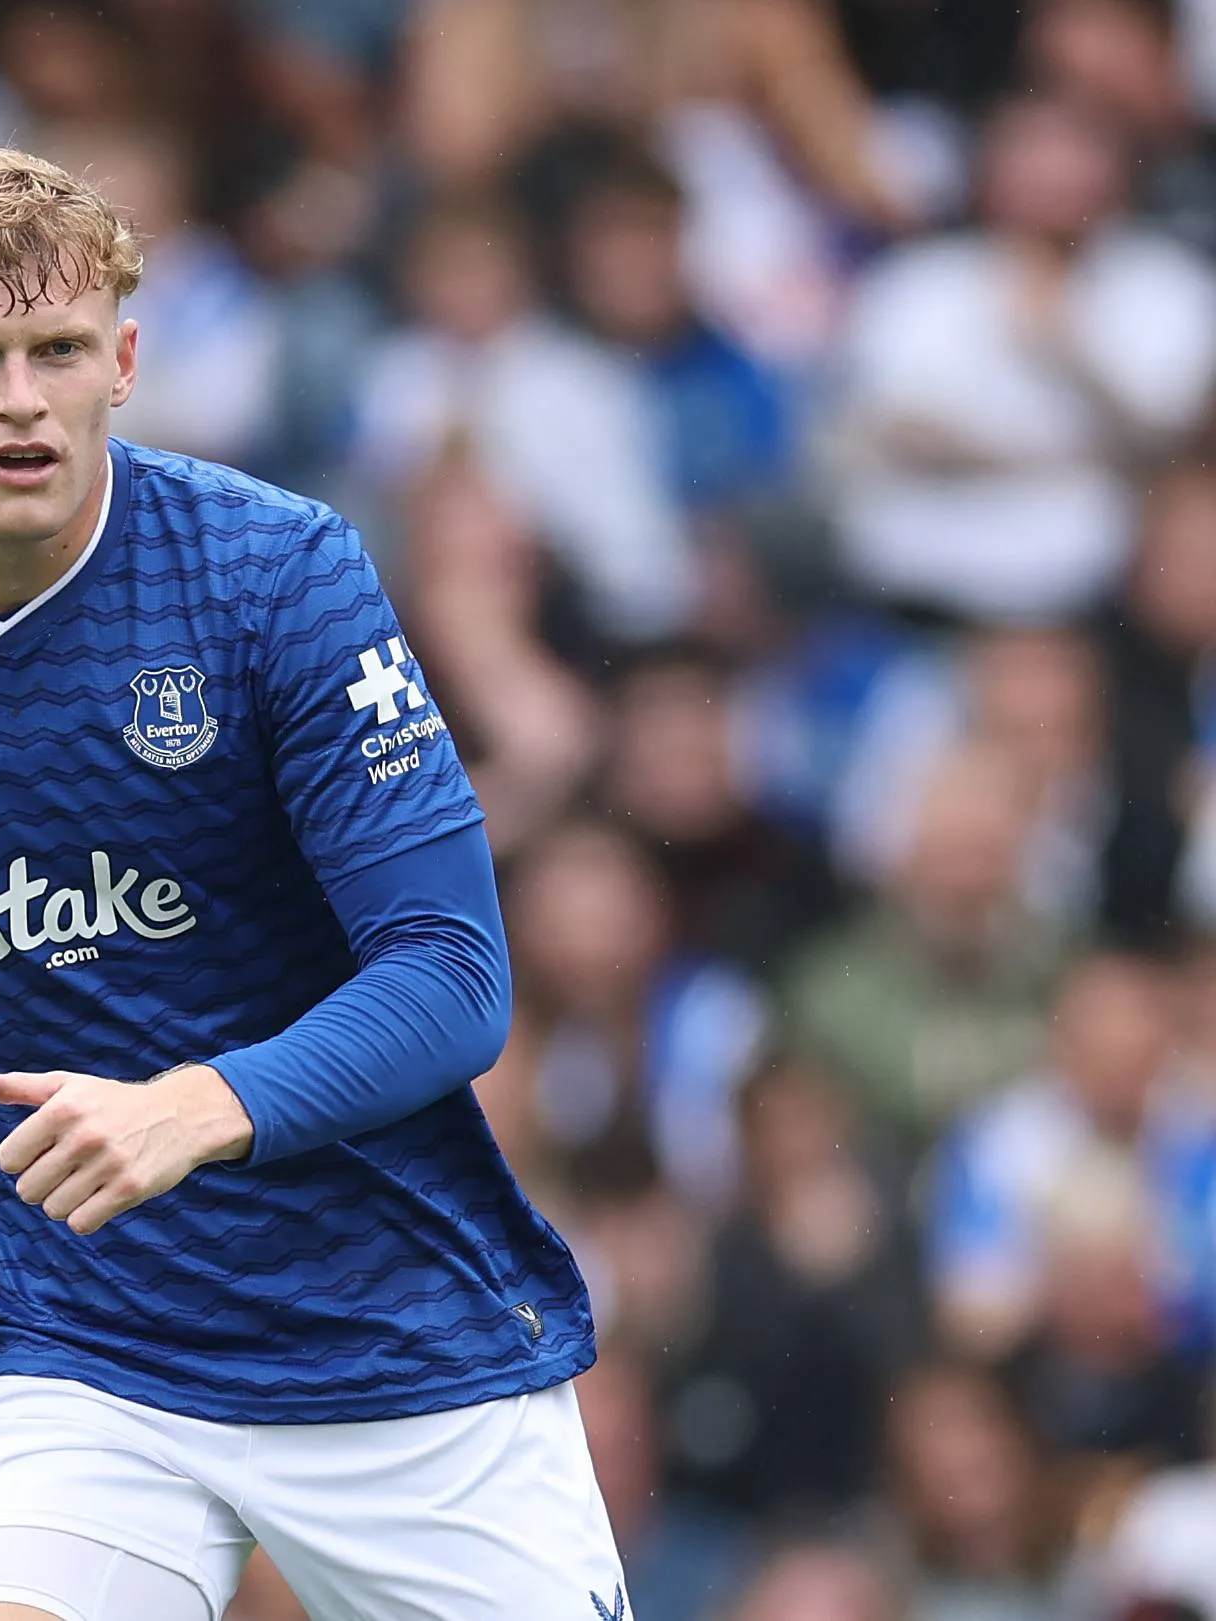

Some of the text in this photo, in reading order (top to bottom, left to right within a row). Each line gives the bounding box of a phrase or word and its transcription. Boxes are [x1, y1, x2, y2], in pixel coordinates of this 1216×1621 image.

[146, 723, 198, 738] Everton
[361, 712, 447, 758] Christoph
[129, 731, 215, 765] NIL SATIS NISI OPTIMUM
[368, 746, 420, 784] Ward
[45, 945, 99, 970] .com
